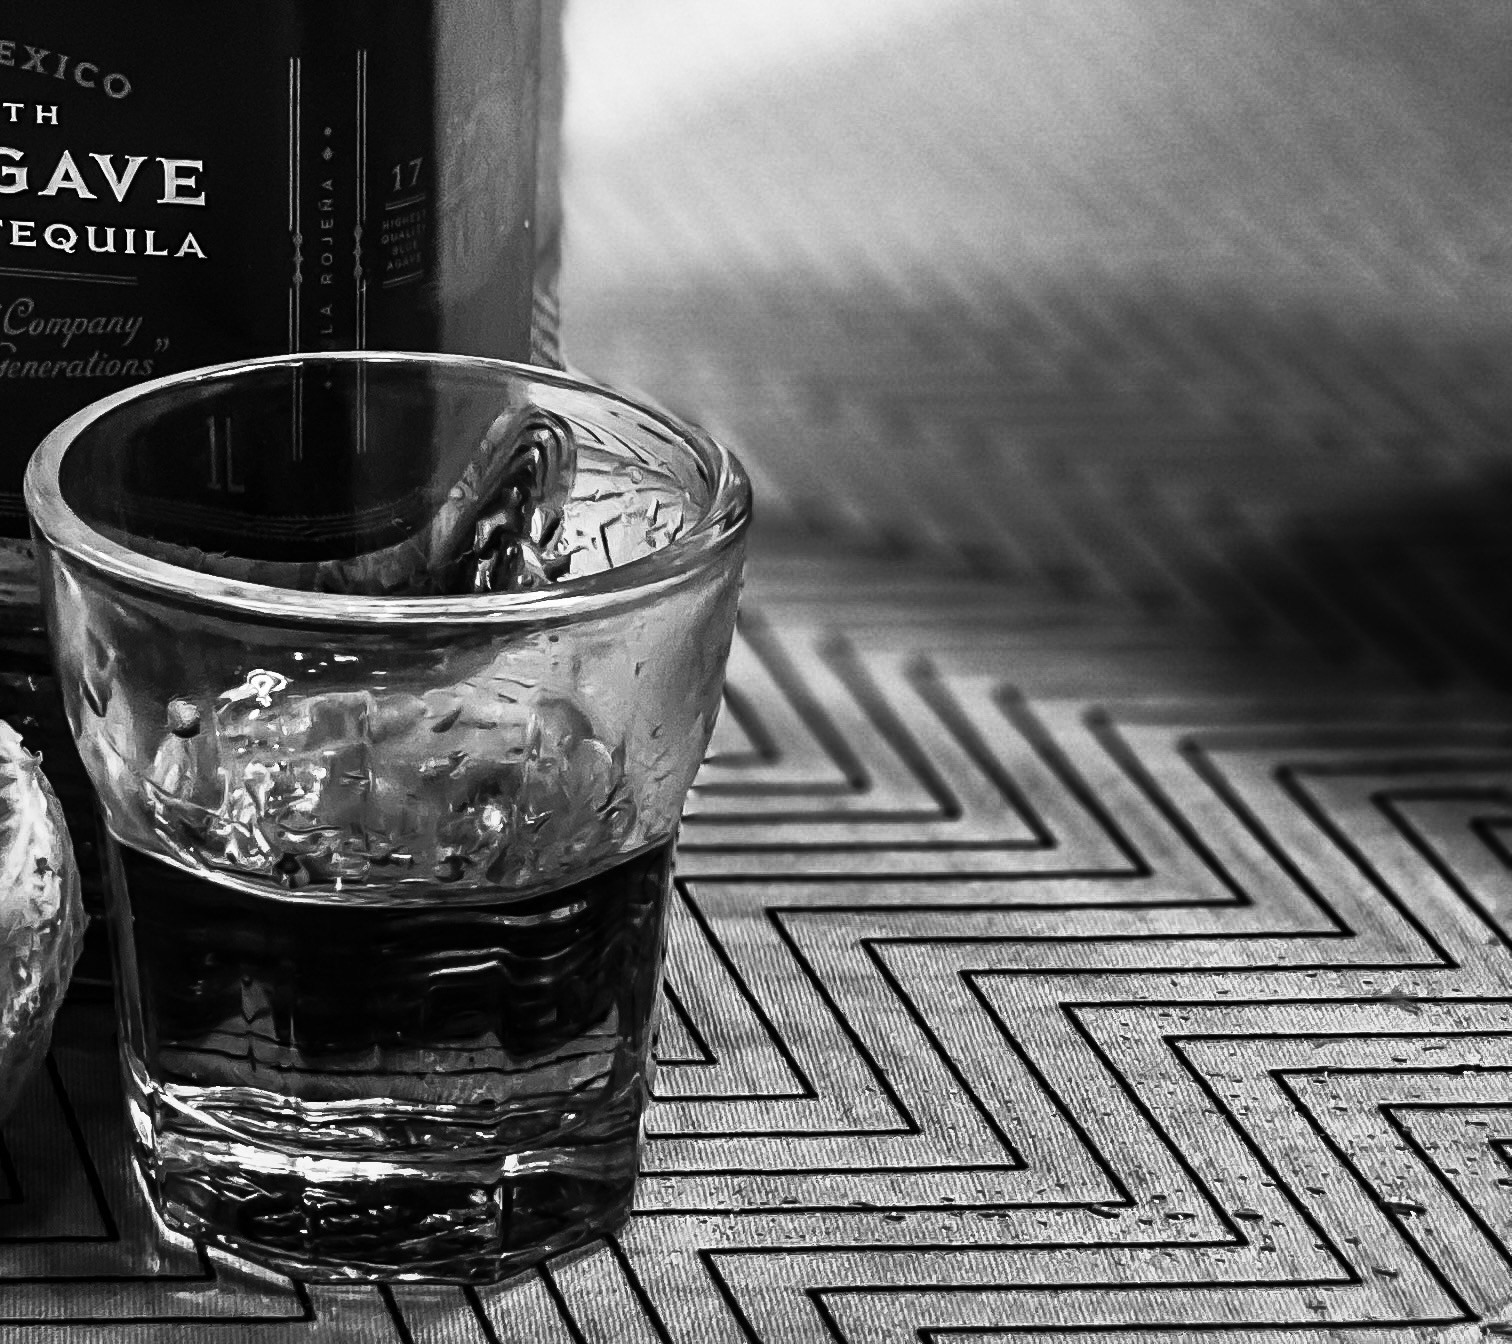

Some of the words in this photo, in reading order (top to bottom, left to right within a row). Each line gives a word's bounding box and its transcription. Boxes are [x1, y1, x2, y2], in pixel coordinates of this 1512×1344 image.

[391, 157, 424, 192] 17
[2, 297, 144, 349] Company
[319, 303, 334, 335] LA
[205, 414, 246, 494] 1L
